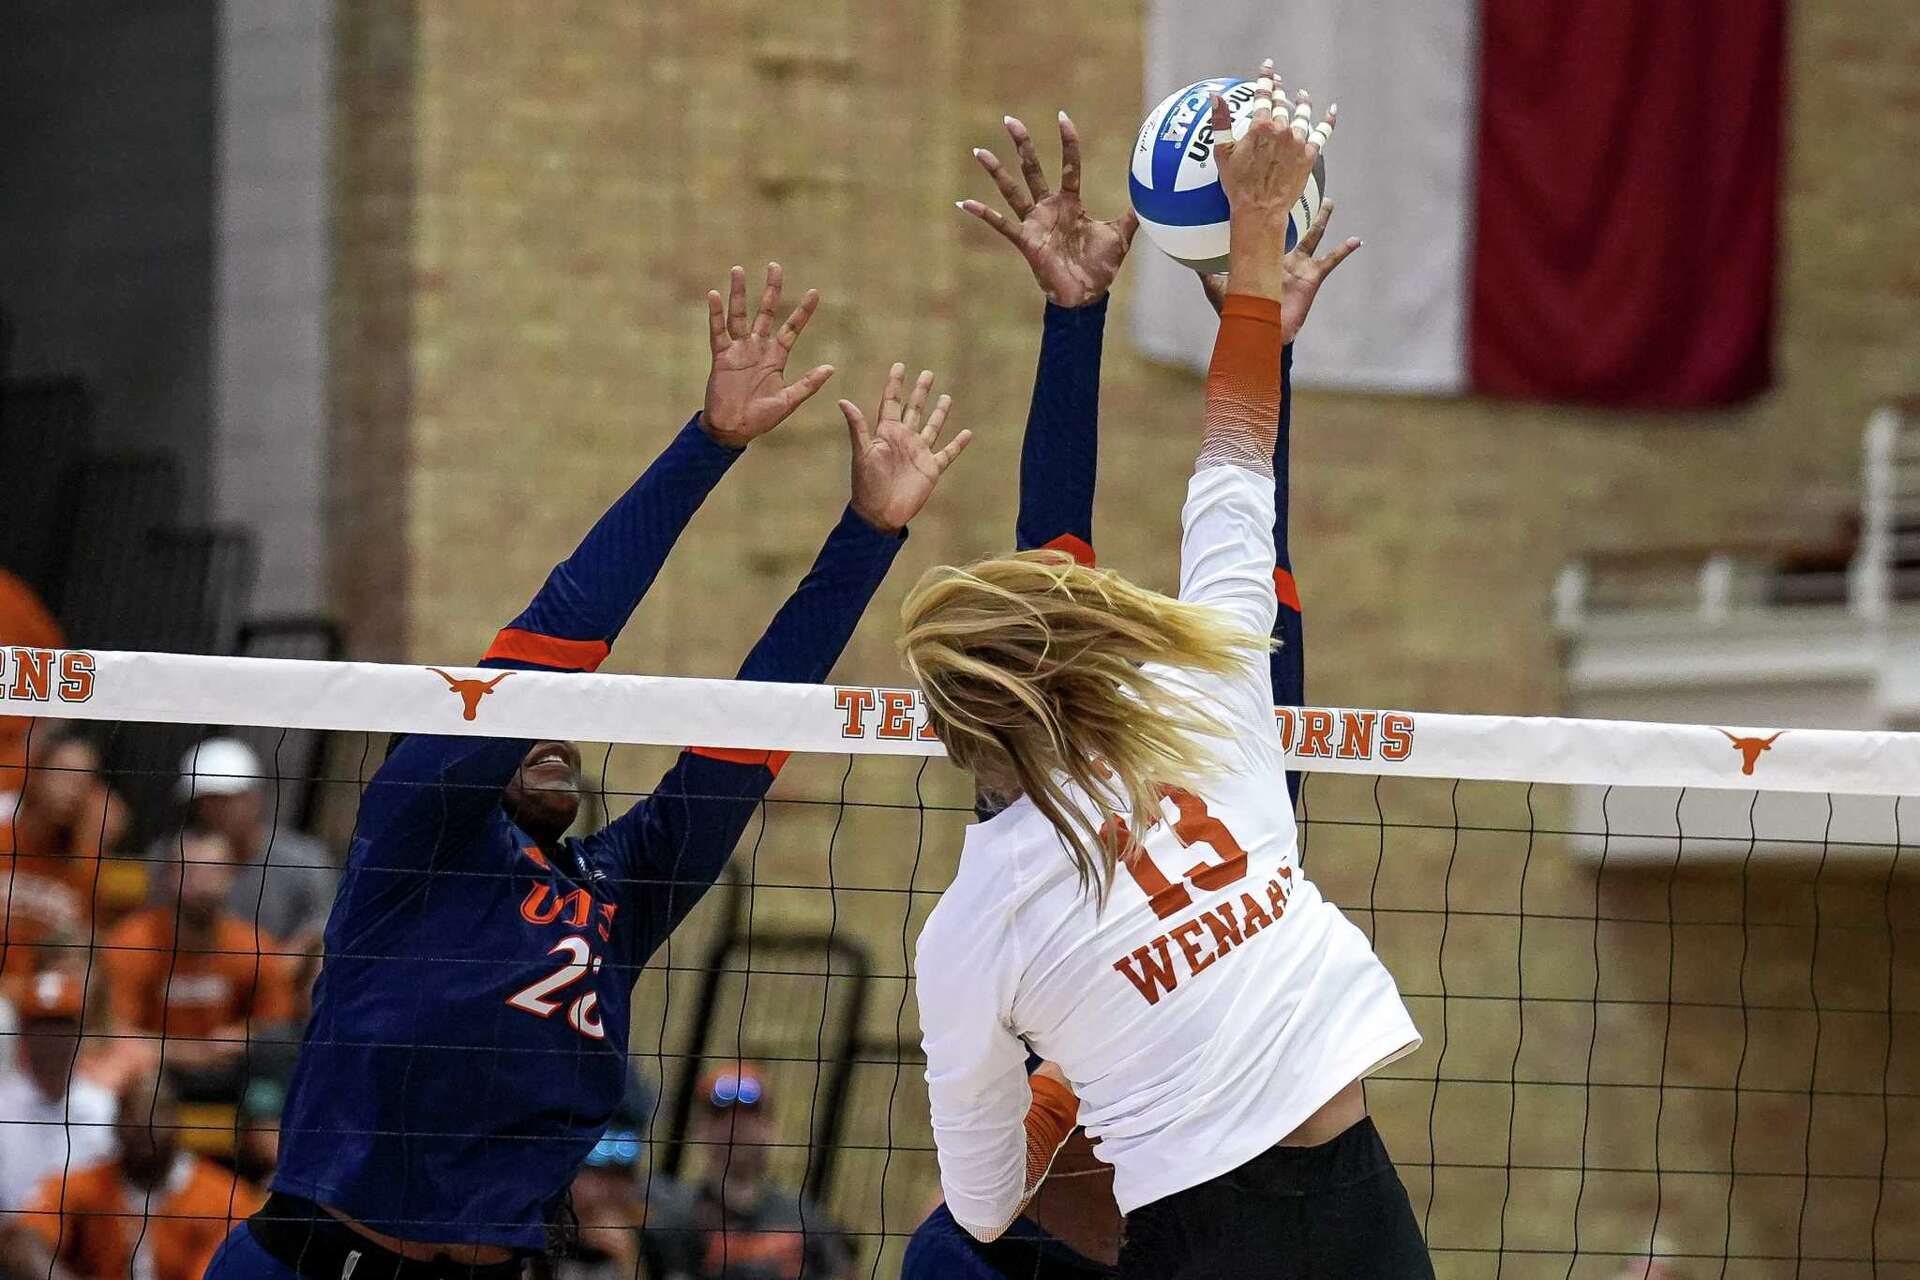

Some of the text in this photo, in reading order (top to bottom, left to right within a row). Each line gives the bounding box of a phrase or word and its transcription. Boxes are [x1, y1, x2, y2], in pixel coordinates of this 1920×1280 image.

[1188, 86, 1255, 162] moen
[0, 647, 95, 703] NS
[1099, 780, 1248, 920] 13
